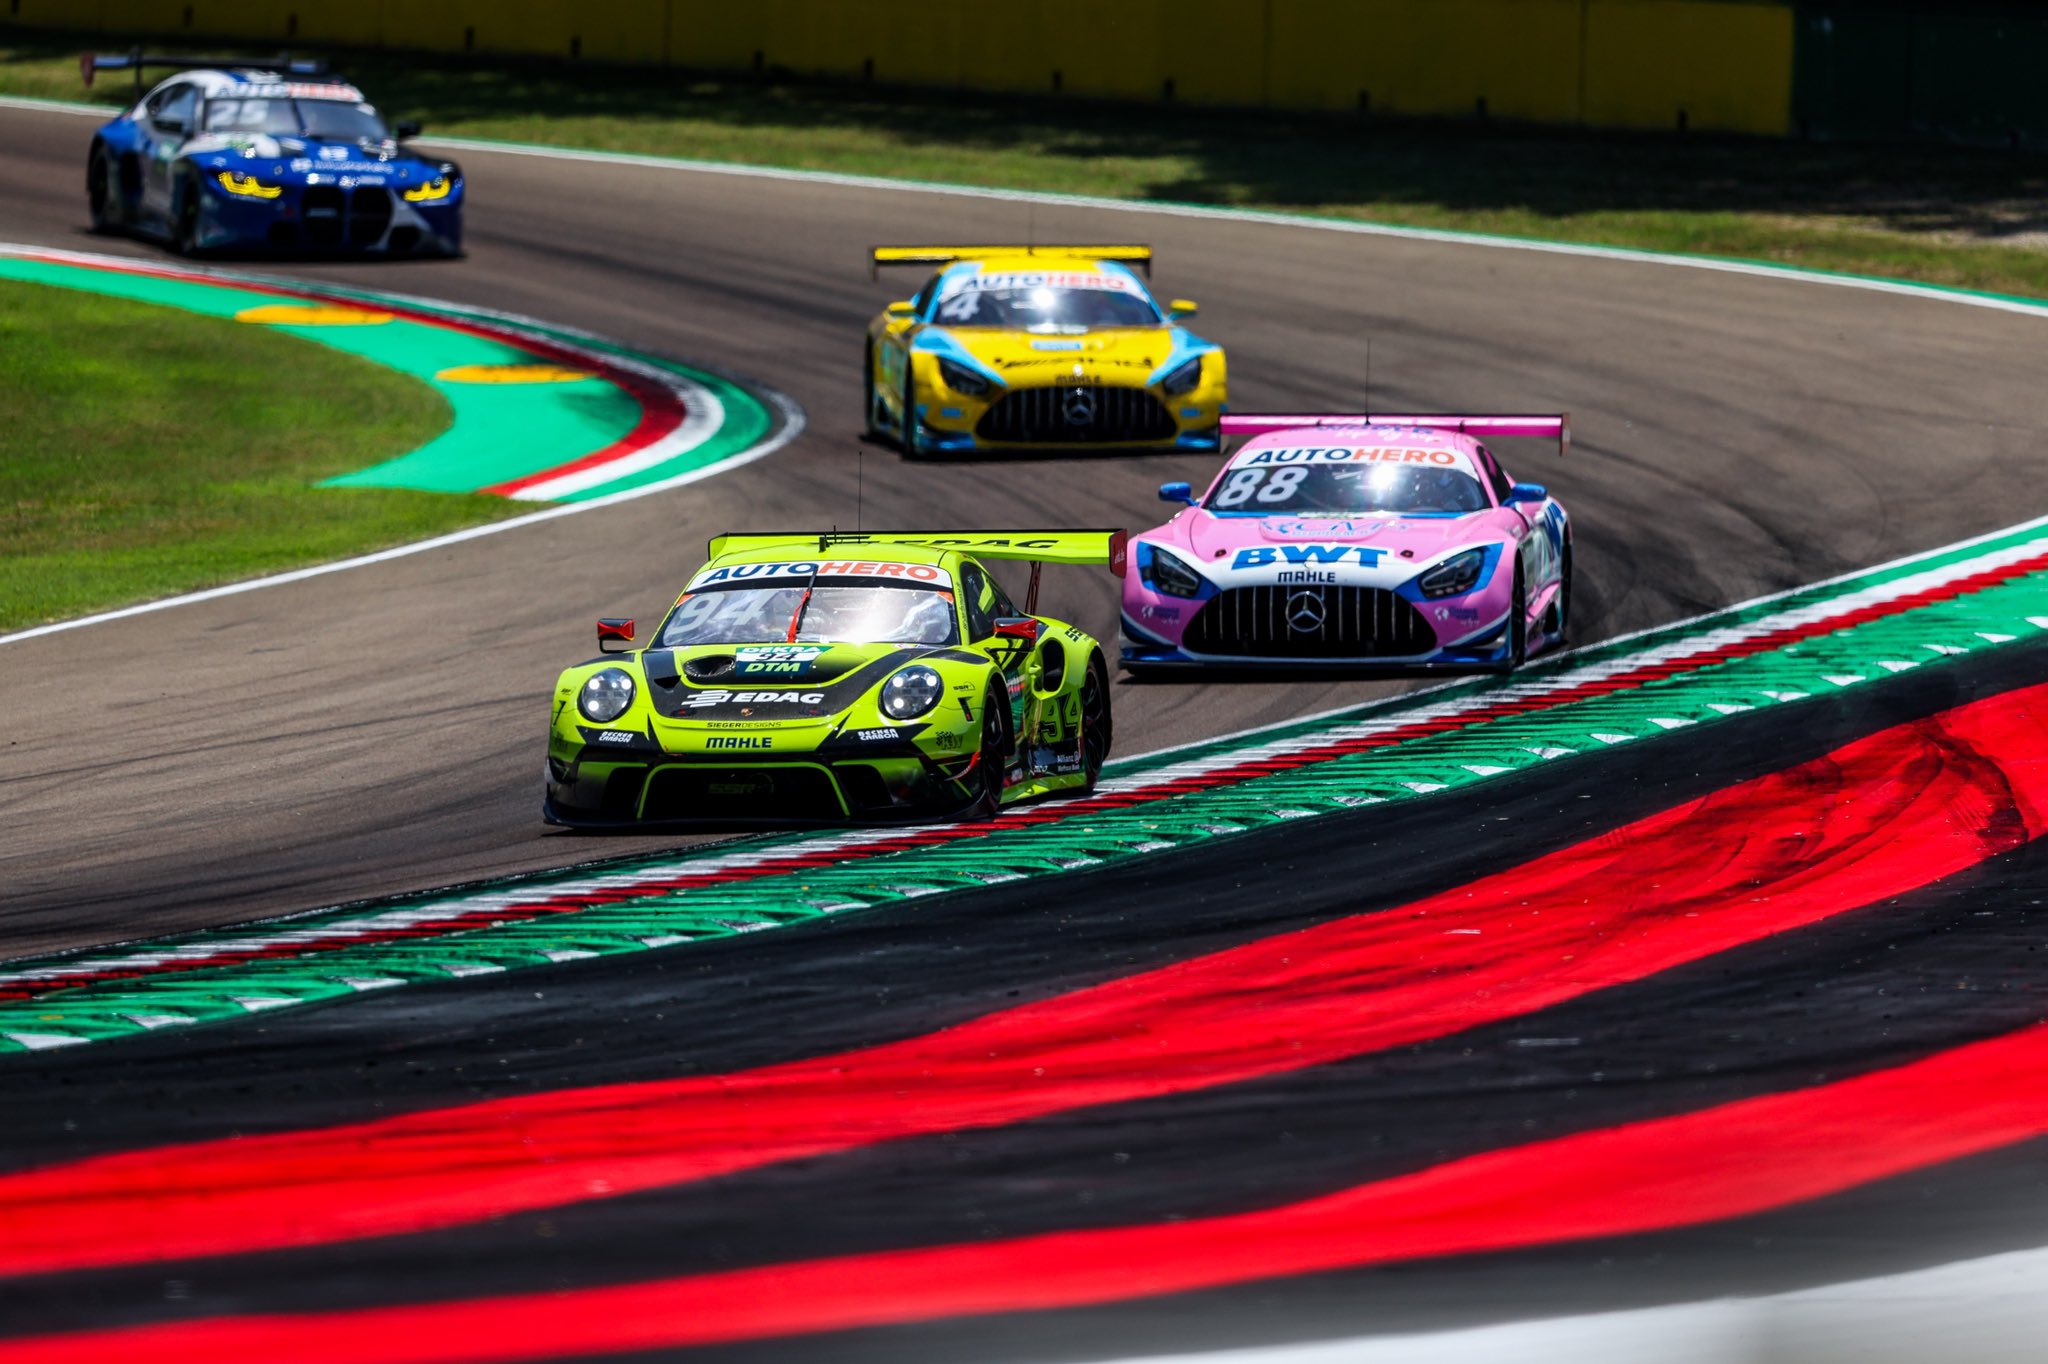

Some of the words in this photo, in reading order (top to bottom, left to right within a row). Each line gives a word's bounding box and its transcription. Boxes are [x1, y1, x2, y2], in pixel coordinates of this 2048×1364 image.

[964, 275, 1125, 290] AUTOHERO
[941, 292, 980, 321] 4
[1248, 448, 1456, 466] AUTOHERO
[1215, 466, 1309, 507] 88
[1231, 545, 1388, 570] BWT
[701, 562, 938, 584] AUTOHERO
[1278, 571, 1336, 583] MAHLE
[663, 588, 780, 634] 94
[756, 653, 800, 661] 94
[744, 662, 801, 672] DTM
[731, 692, 825, 704] EDAG
[1038, 688, 1083, 744] 94
[706, 737, 773, 749] MAHLE
[859, 733, 900, 741] CARBON
